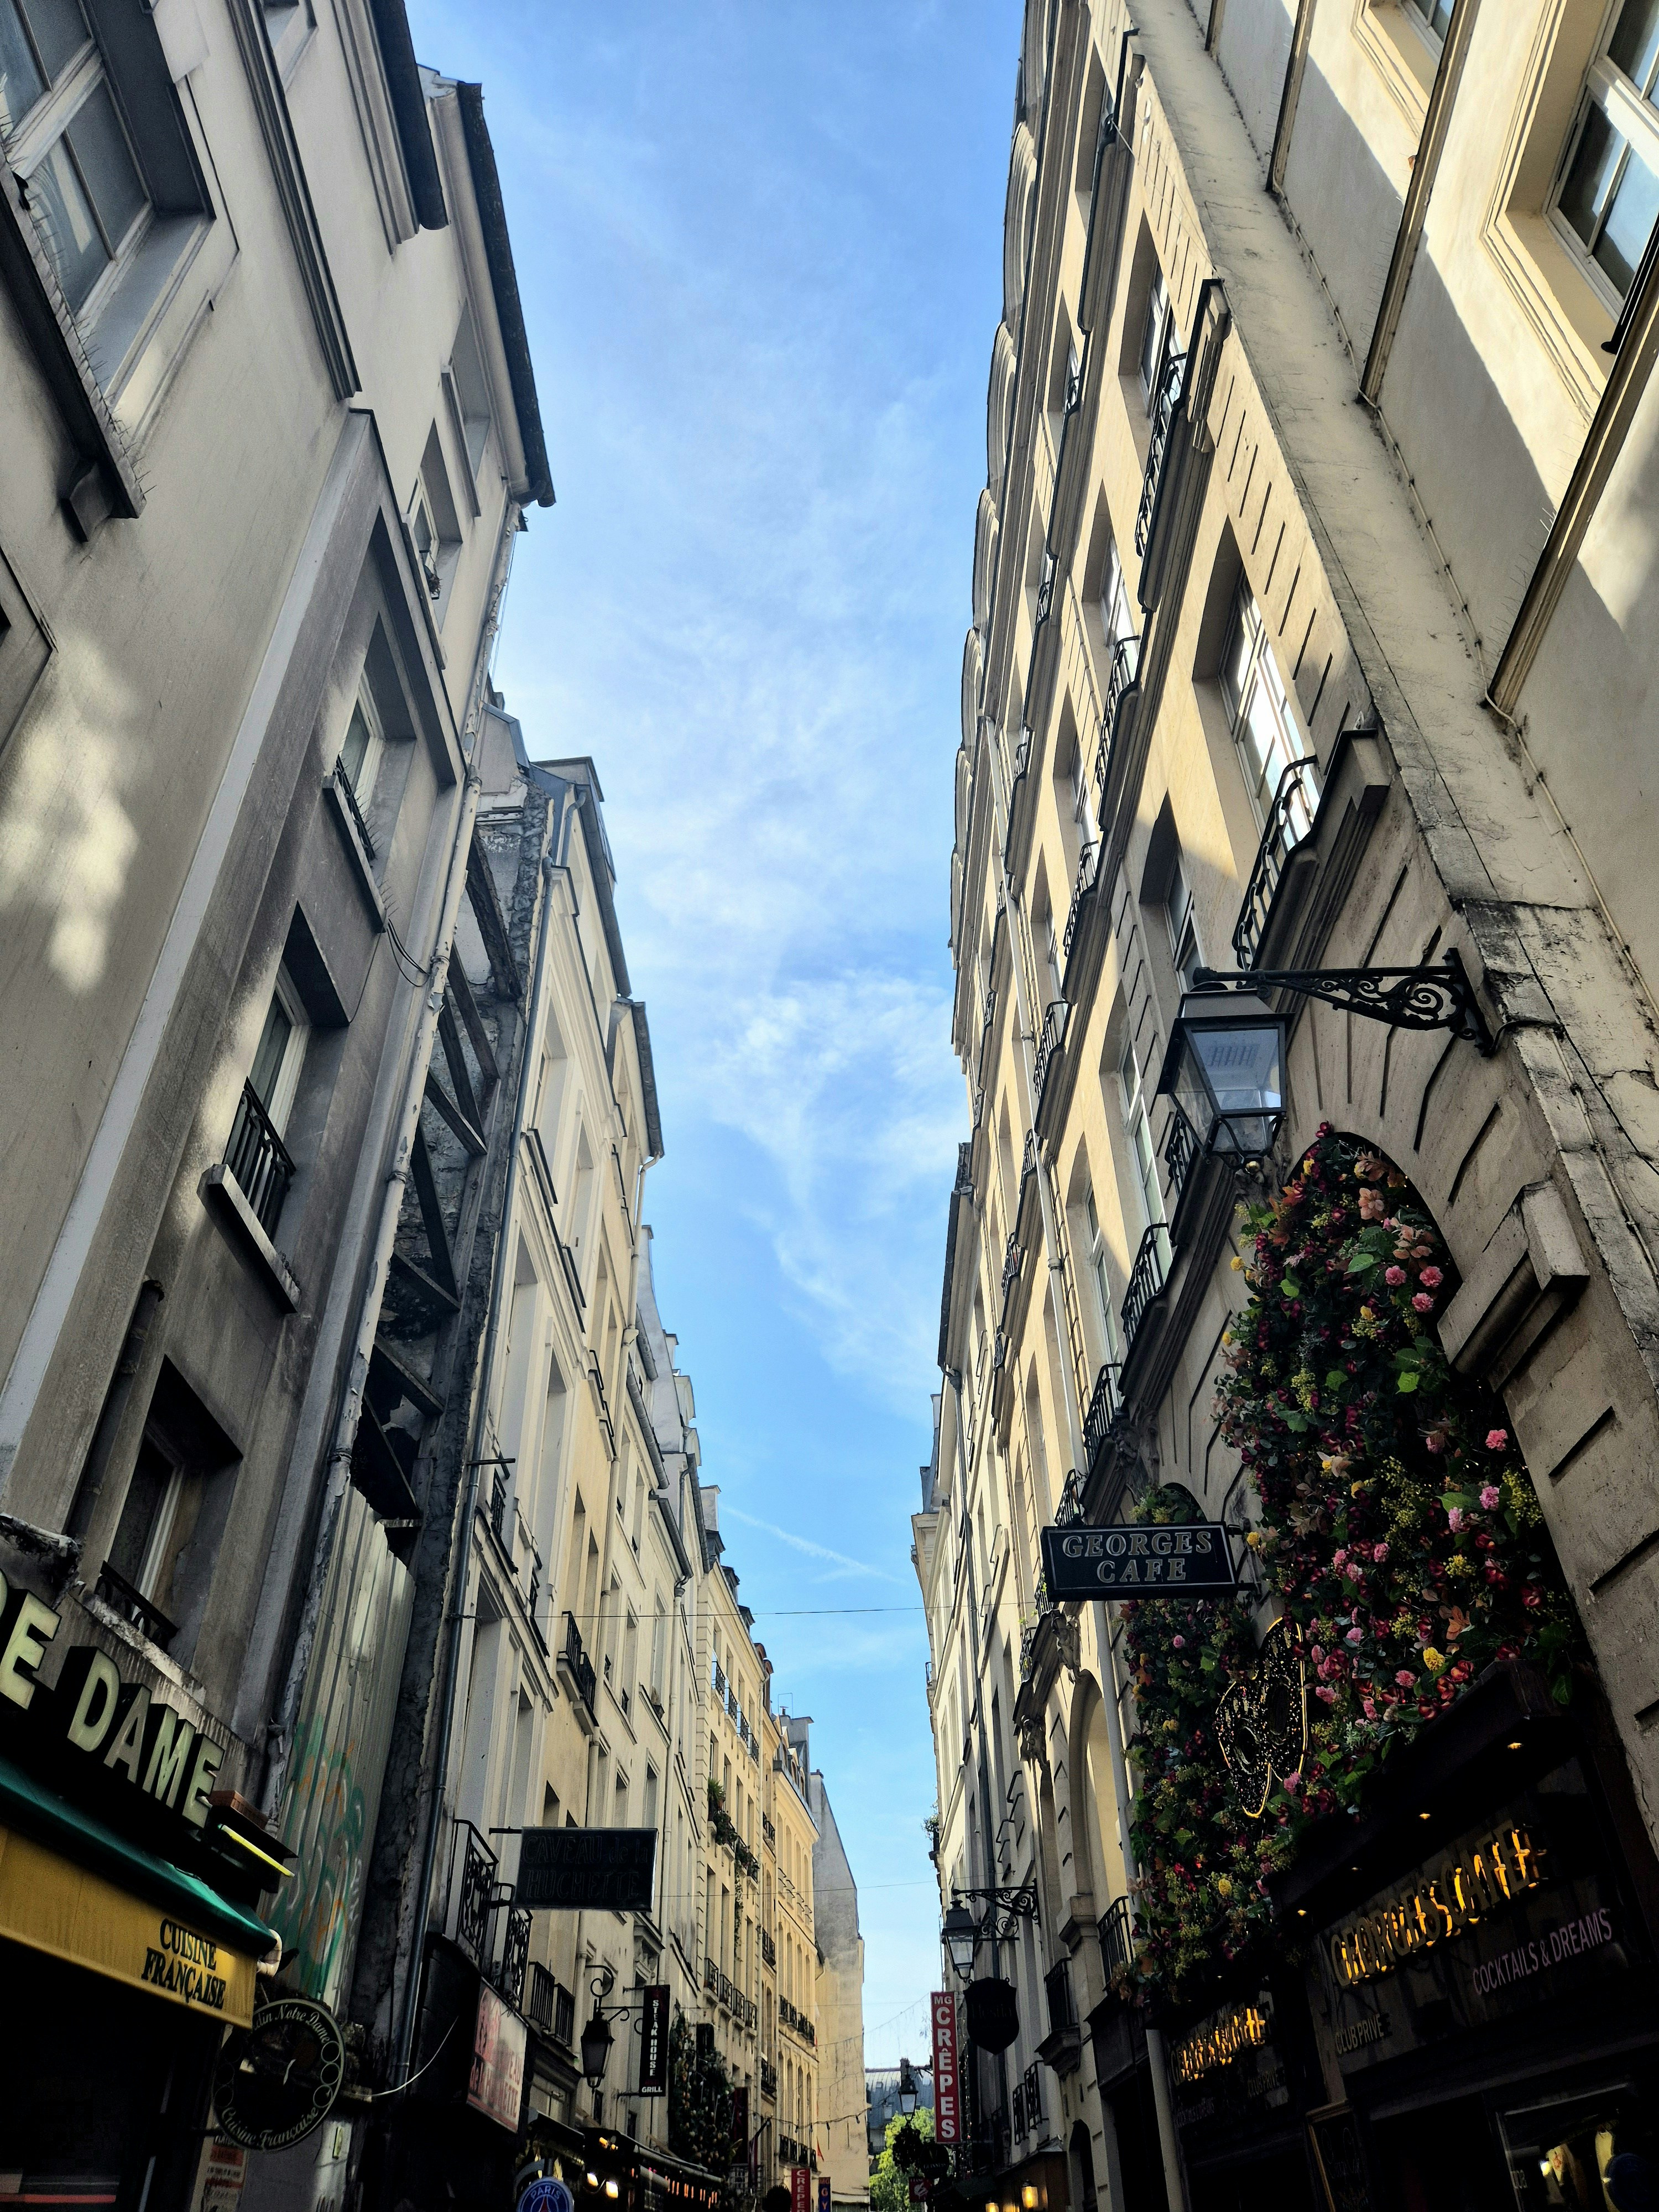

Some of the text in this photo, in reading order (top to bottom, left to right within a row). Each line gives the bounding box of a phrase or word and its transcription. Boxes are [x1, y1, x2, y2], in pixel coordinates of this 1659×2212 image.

[1062, 1531, 1212, 1558] GEORGES
[1097, 1558, 1186, 1583] CAFE
[0, 1567, 225, 1829] E DAME
[523, 1835, 649, 1864] CAVEAU de la
[526, 1868, 640, 1900] HUCHETTE
[160, 1918, 217, 1971] CUISINE
[1472, 1907, 1613, 1996] COCKTAILS & DREAMS
[141, 1947, 226, 2010] FRANÇAISE
[651, 2000, 659, 2036] STEAK
[934, 1996, 952, 2005] MG
[275, 2004, 307, 2022] Notre
[305, 2011, 331, 2044] Dame
[1335, 2025, 1358, 2054] CLUB
[649, 2039, 658, 2077] HOUSE
[936, 2006, 955, 2138] CRÊPES
[222, 2106, 319, 2150] Cuisine Française
[530, 2185, 562, 2200] PARIS
